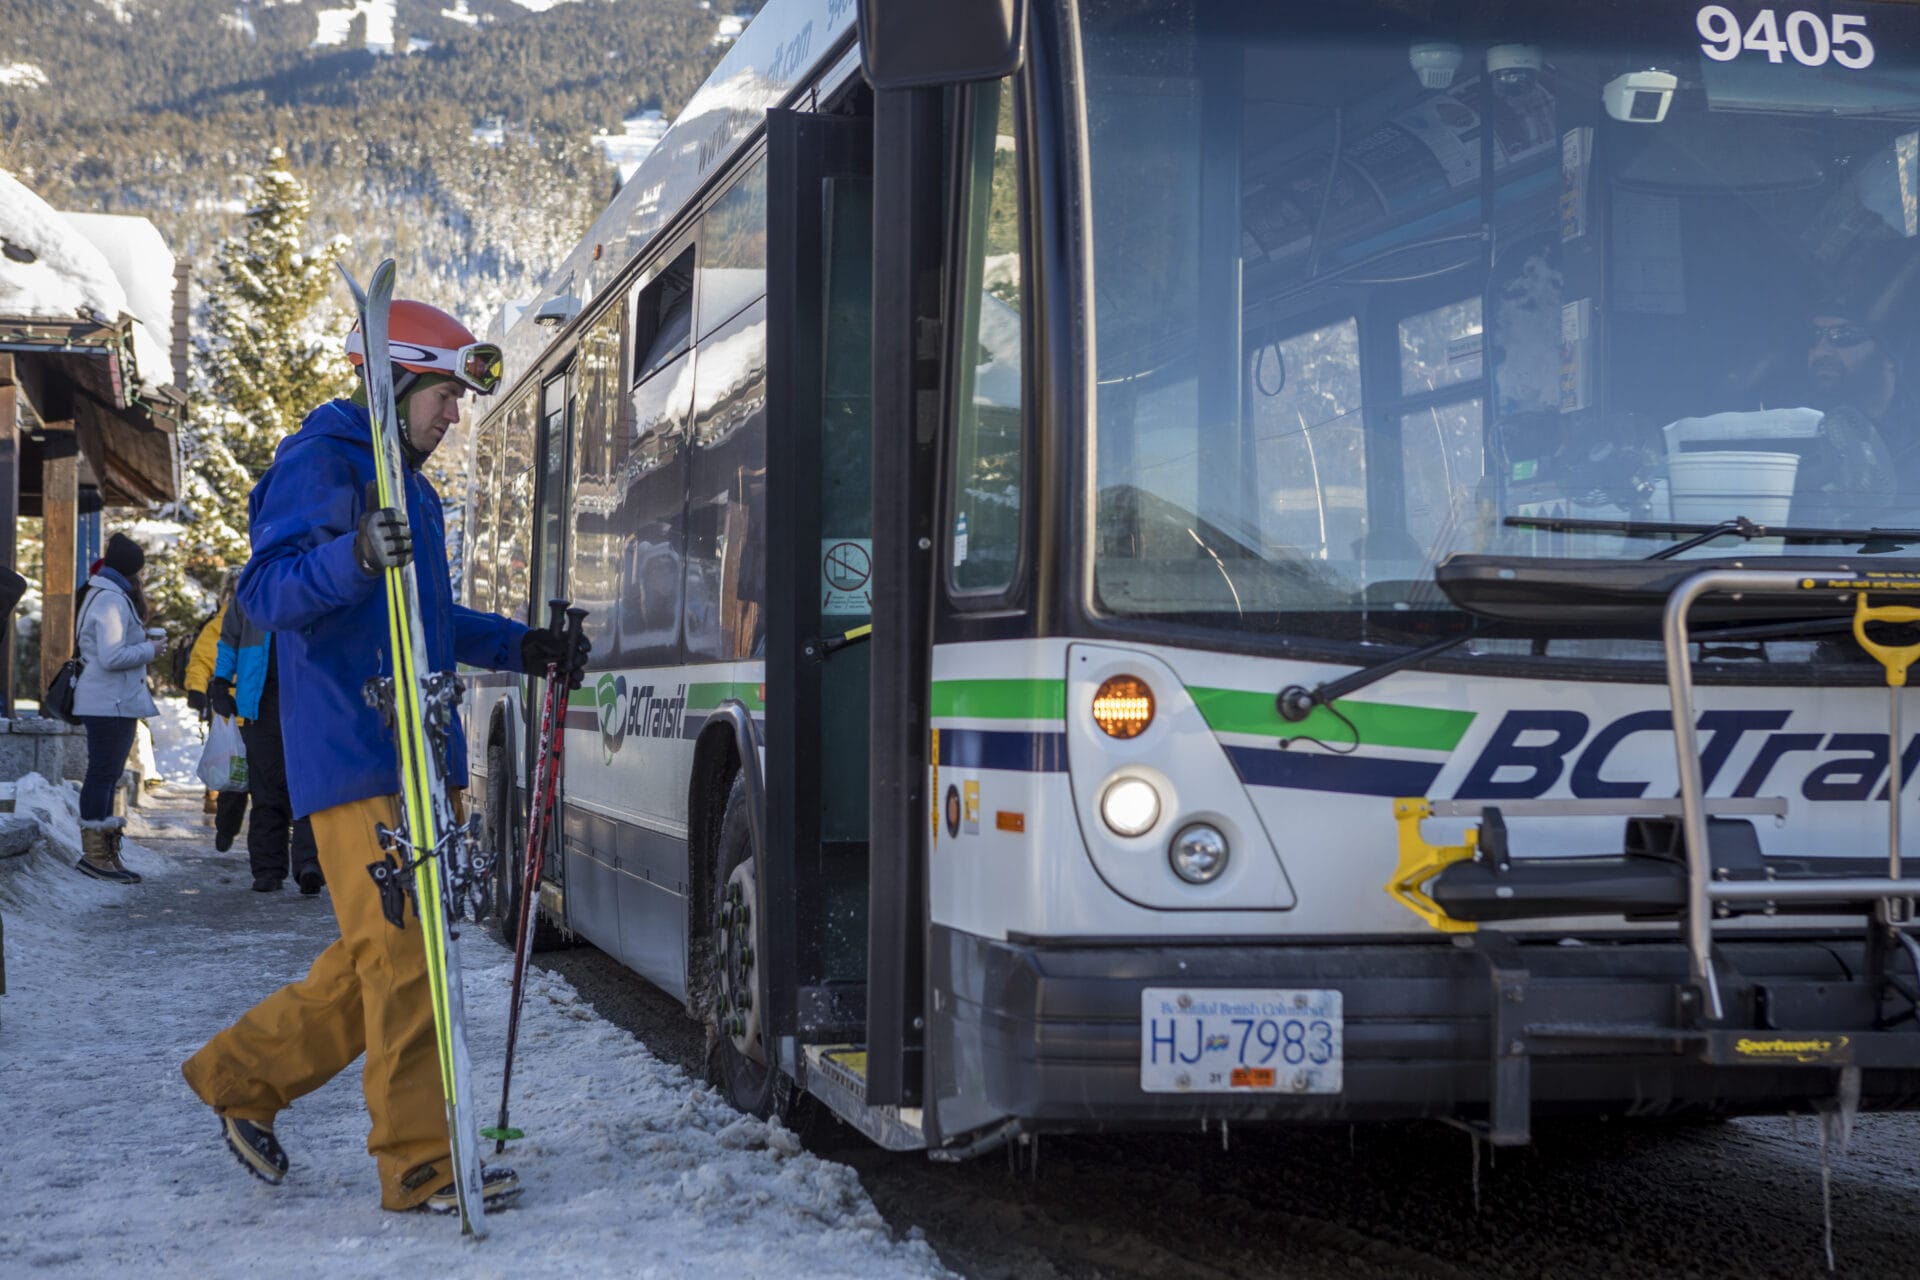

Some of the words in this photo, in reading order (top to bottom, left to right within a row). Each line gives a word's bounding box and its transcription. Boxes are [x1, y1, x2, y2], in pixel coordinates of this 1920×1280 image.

[1696, 5, 1875, 69] 9405
[1150, 1019, 1203, 1064] HJ
[1230, 1019, 1333, 1065] 7983
